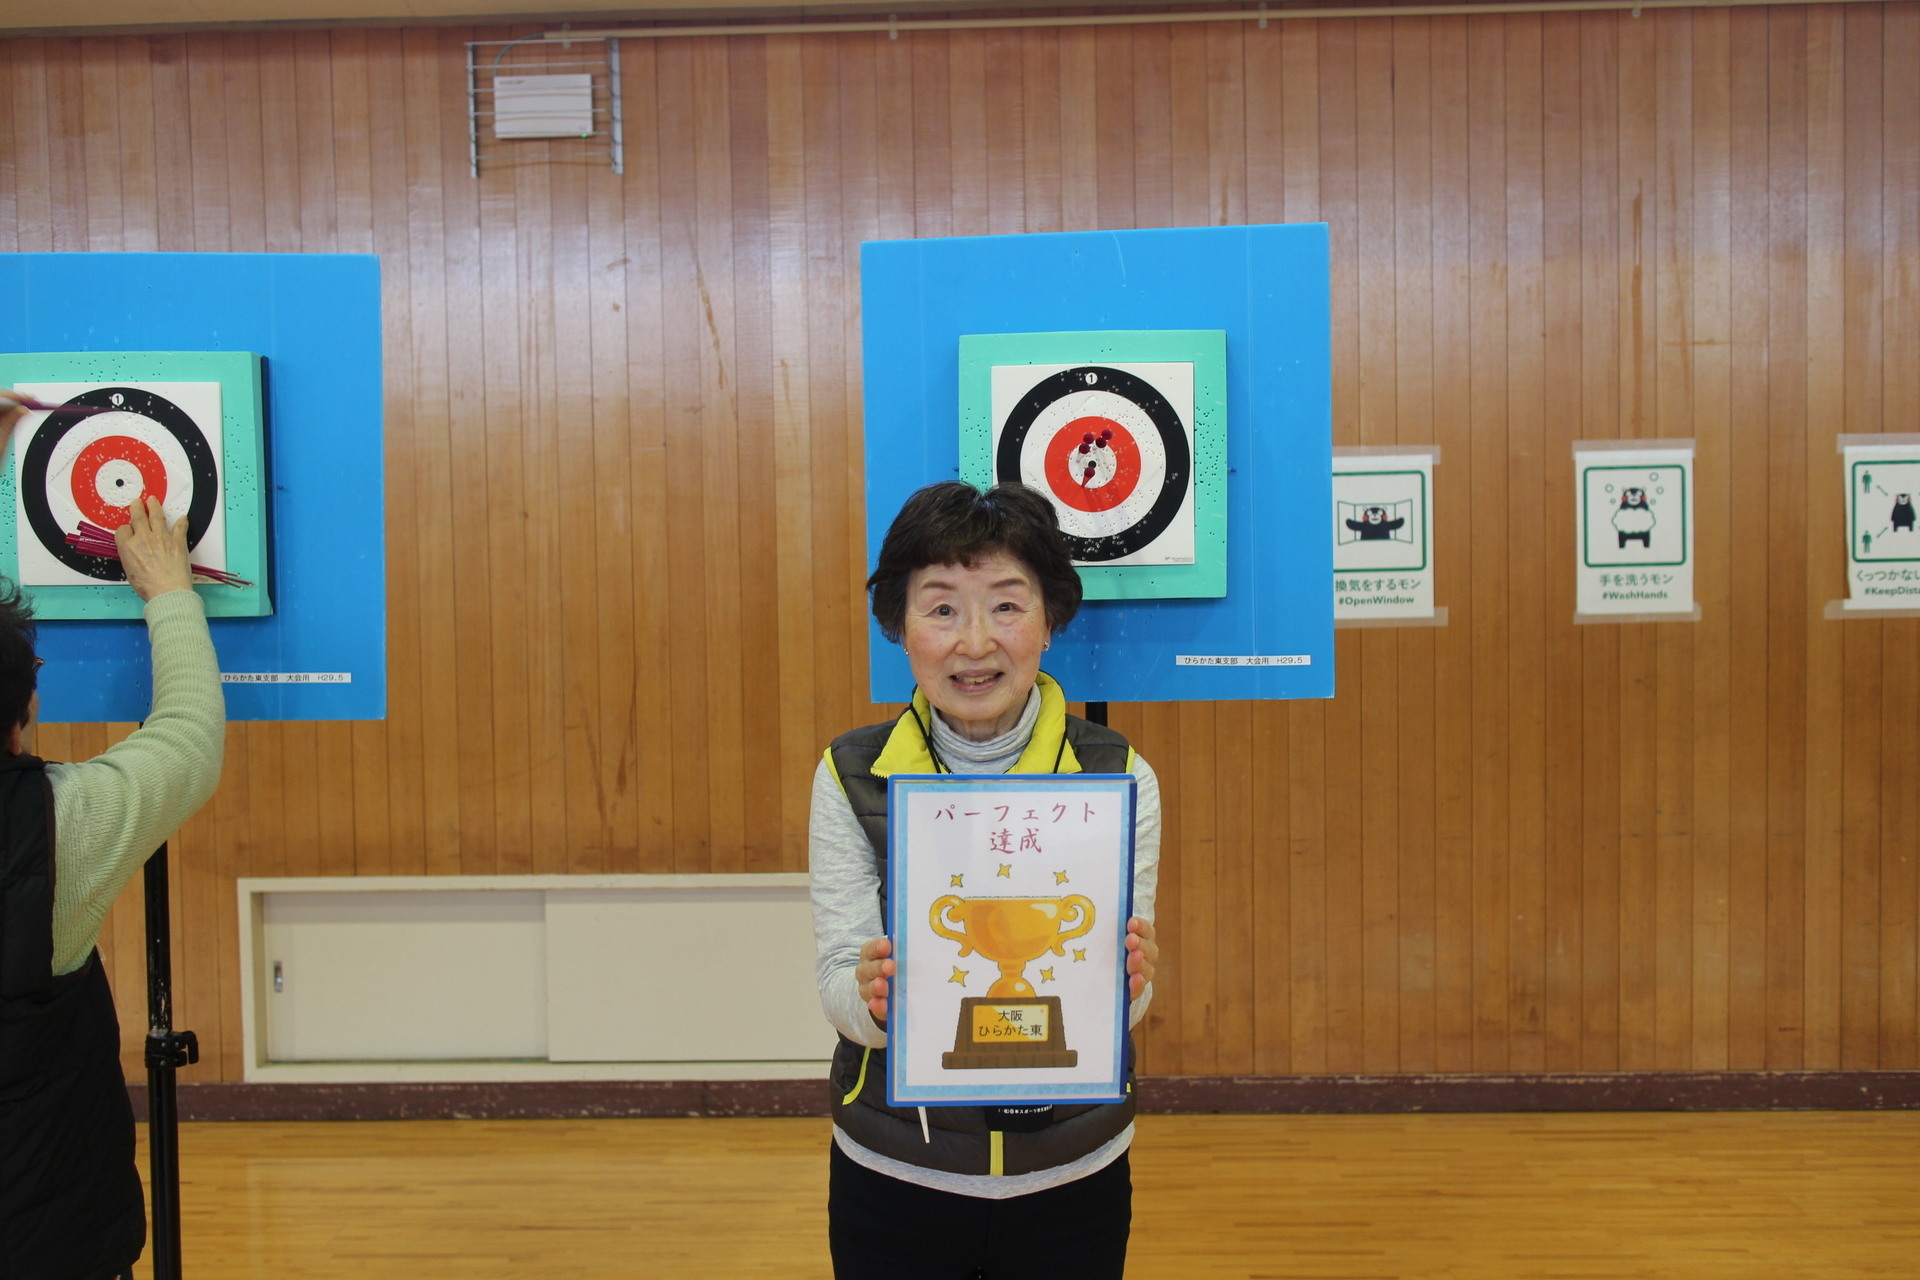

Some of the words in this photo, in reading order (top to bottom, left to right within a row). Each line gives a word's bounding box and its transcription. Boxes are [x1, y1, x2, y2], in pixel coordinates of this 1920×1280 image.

[1335, 578, 1421, 591] 換気をするモン
[1600, 573, 1673, 587] 手を洗うモン
[1339, 595, 1414, 607] #OpenWindow
[1602, 590, 1668, 600] #WashHands
[1184, 656, 1238, 665] ひらかた東支部
[1246, 656, 1269, 665] 大会用
[1276, 656, 1302, 664] H29.5
[224, 674, 279, 683] ひらかた東支部
[317, 673, 343, 681] H29.5
[935, 802, 1095, 823] パーフェクト
[989, 828, 1042, 854] 達成
[998, 1010, 1023, 1022] 大阪
[978, 1024, 1042, 1036] ひらかた東
